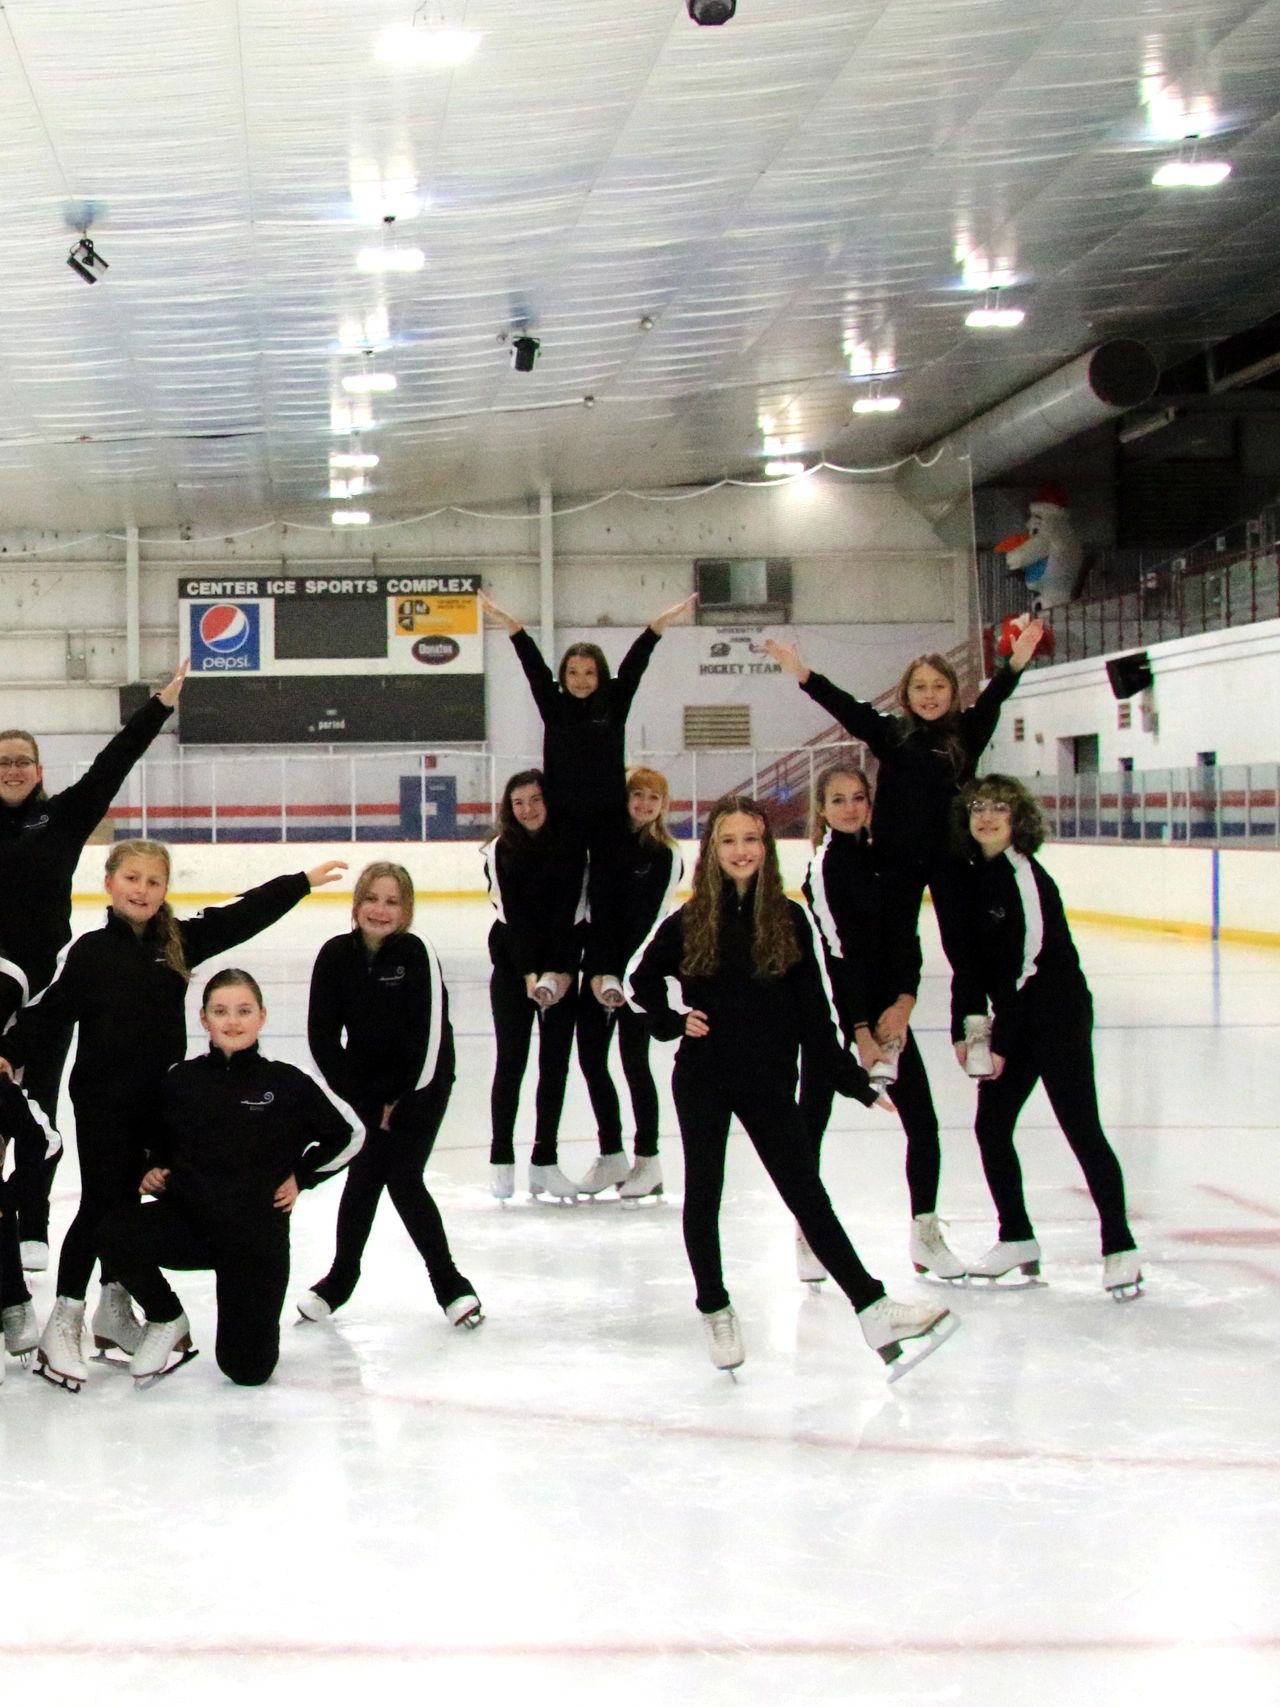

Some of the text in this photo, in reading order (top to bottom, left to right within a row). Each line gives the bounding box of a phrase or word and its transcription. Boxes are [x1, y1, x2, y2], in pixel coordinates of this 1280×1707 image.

[186, 579, 473, 595] CENTER ICE SPORTS COMPLEX
[202, 655, 248, 670] pepsi
[700, 663, 782, 675] HOCKEY TEAM
[318, 719, 345, 731] period
